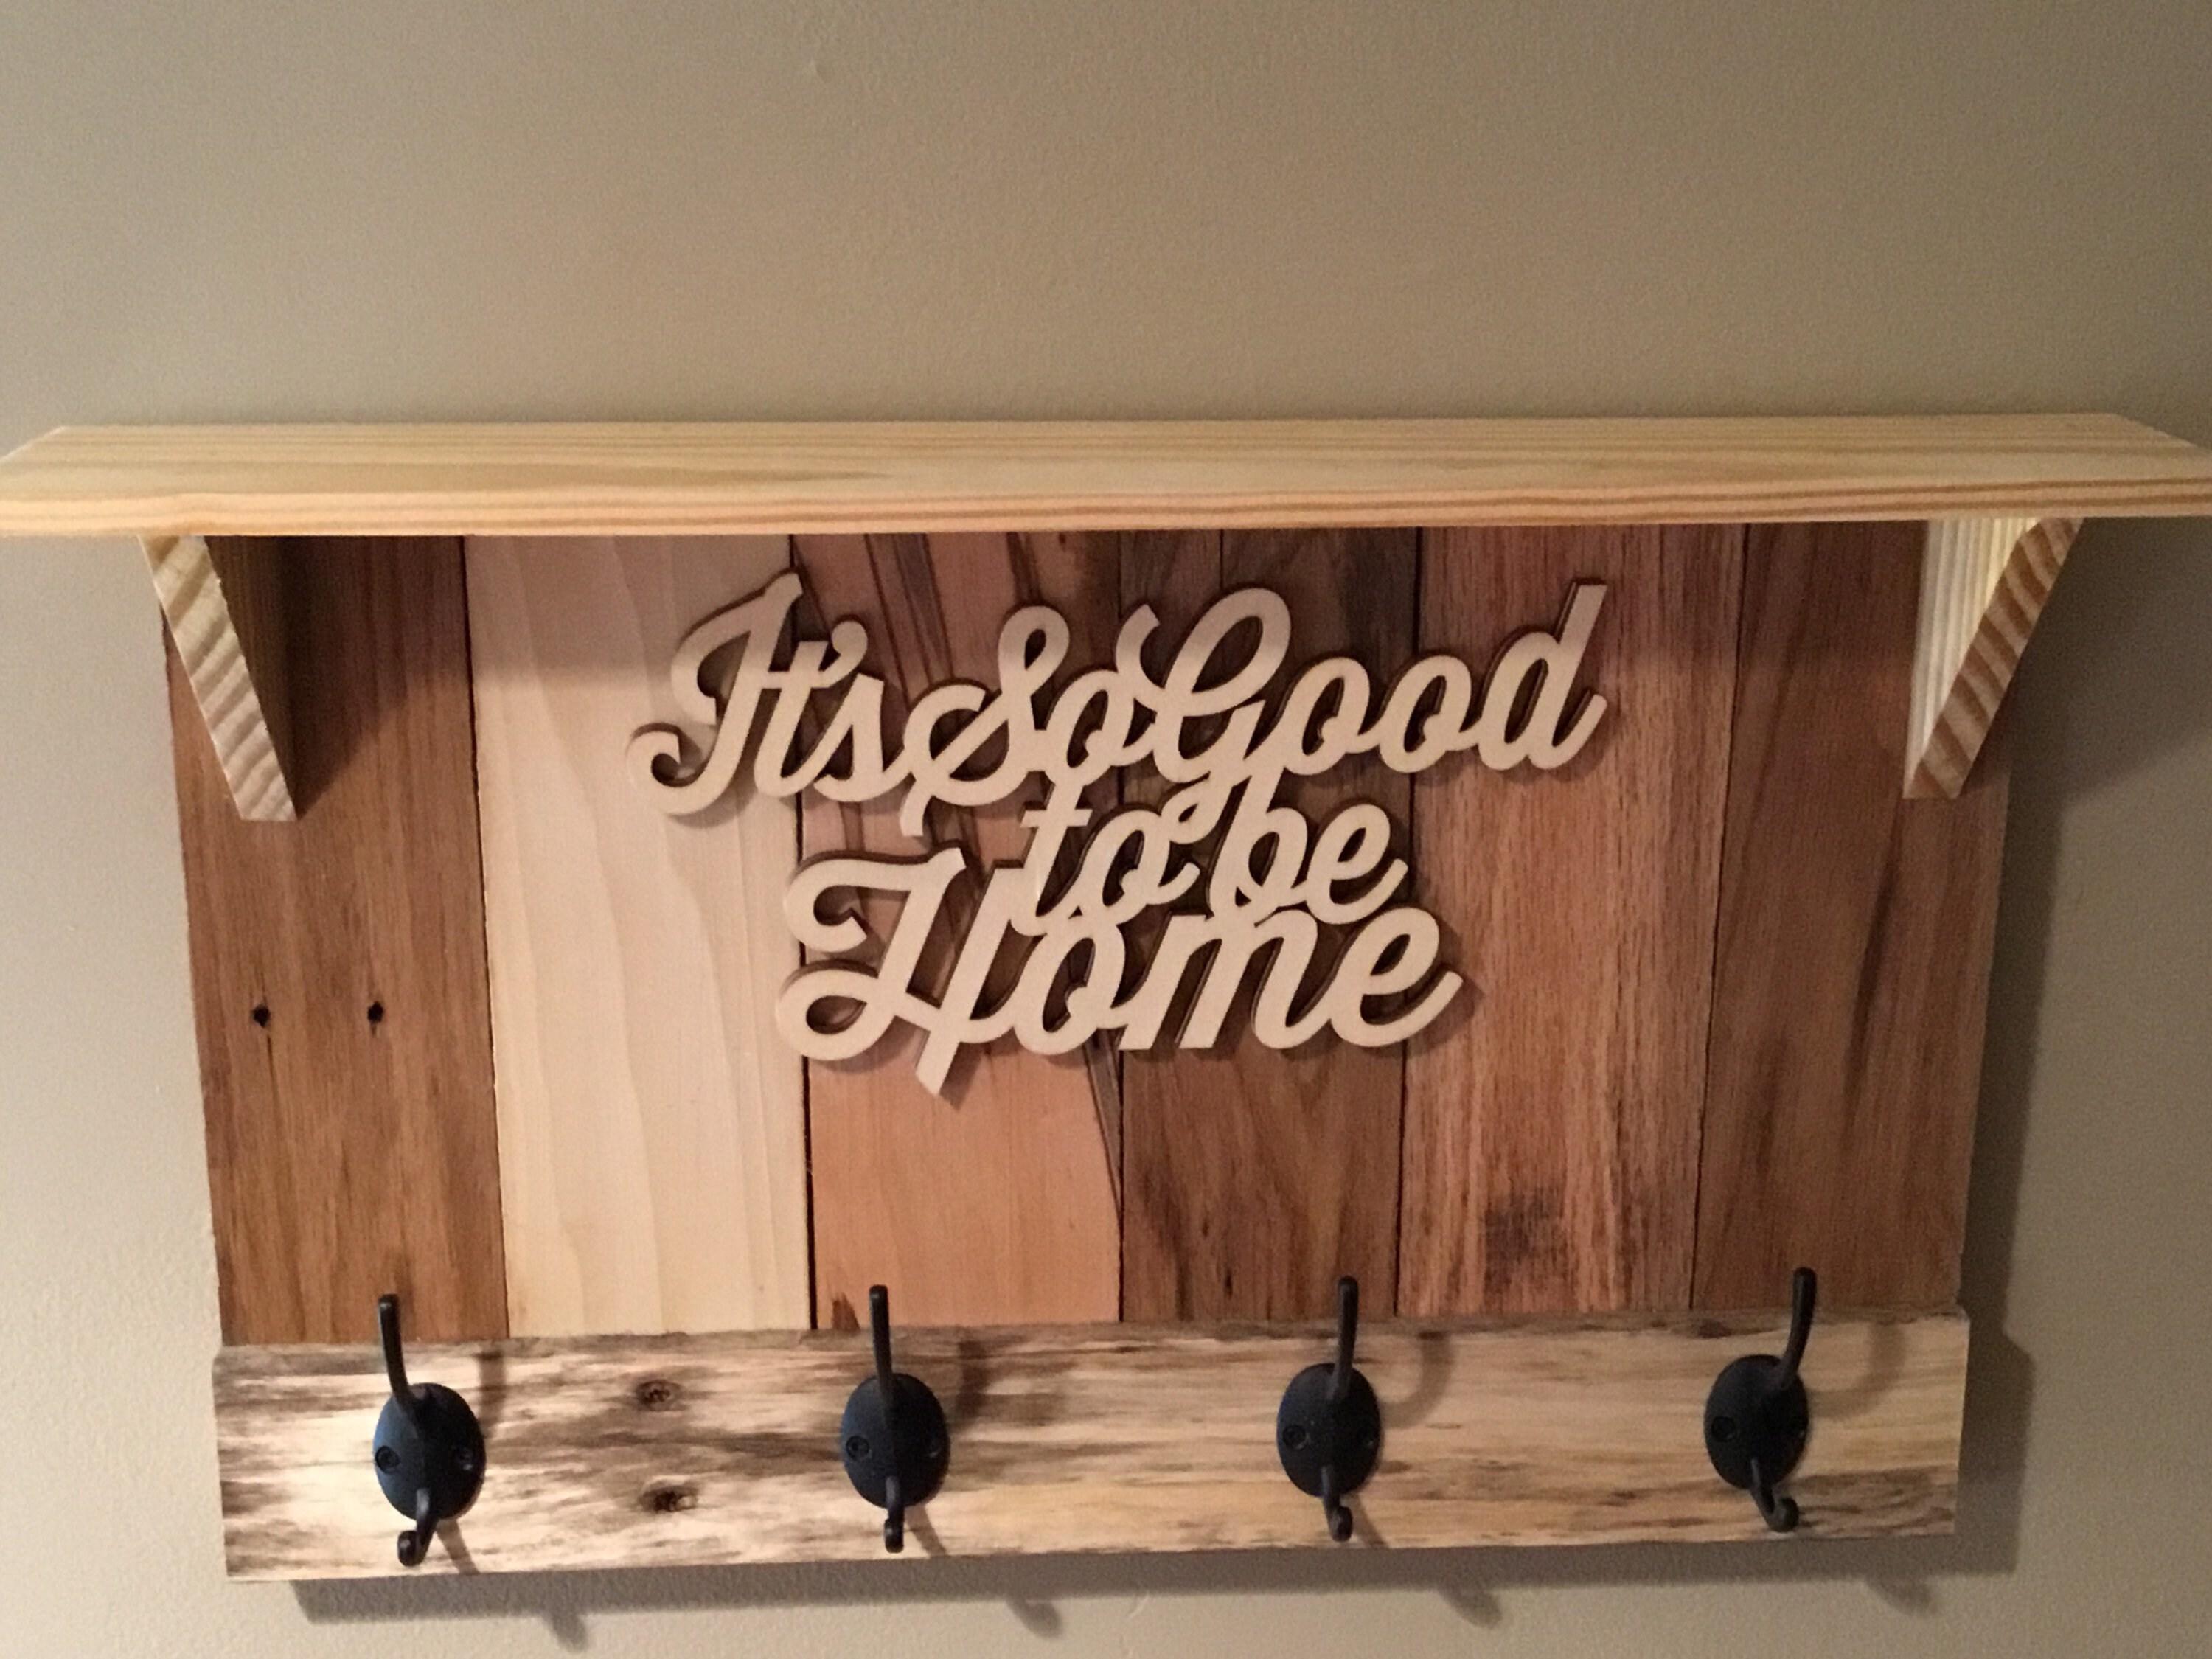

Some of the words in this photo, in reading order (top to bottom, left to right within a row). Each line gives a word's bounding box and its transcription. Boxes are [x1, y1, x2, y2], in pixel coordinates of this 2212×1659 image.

[898, 604, 1159, 838] So
[1116, 584, 1608, 844] Good
[776, 847, 1464, 1096] Home
[1010, 782, 1200, 936] to
[1206, 767, 1410, 925] be
